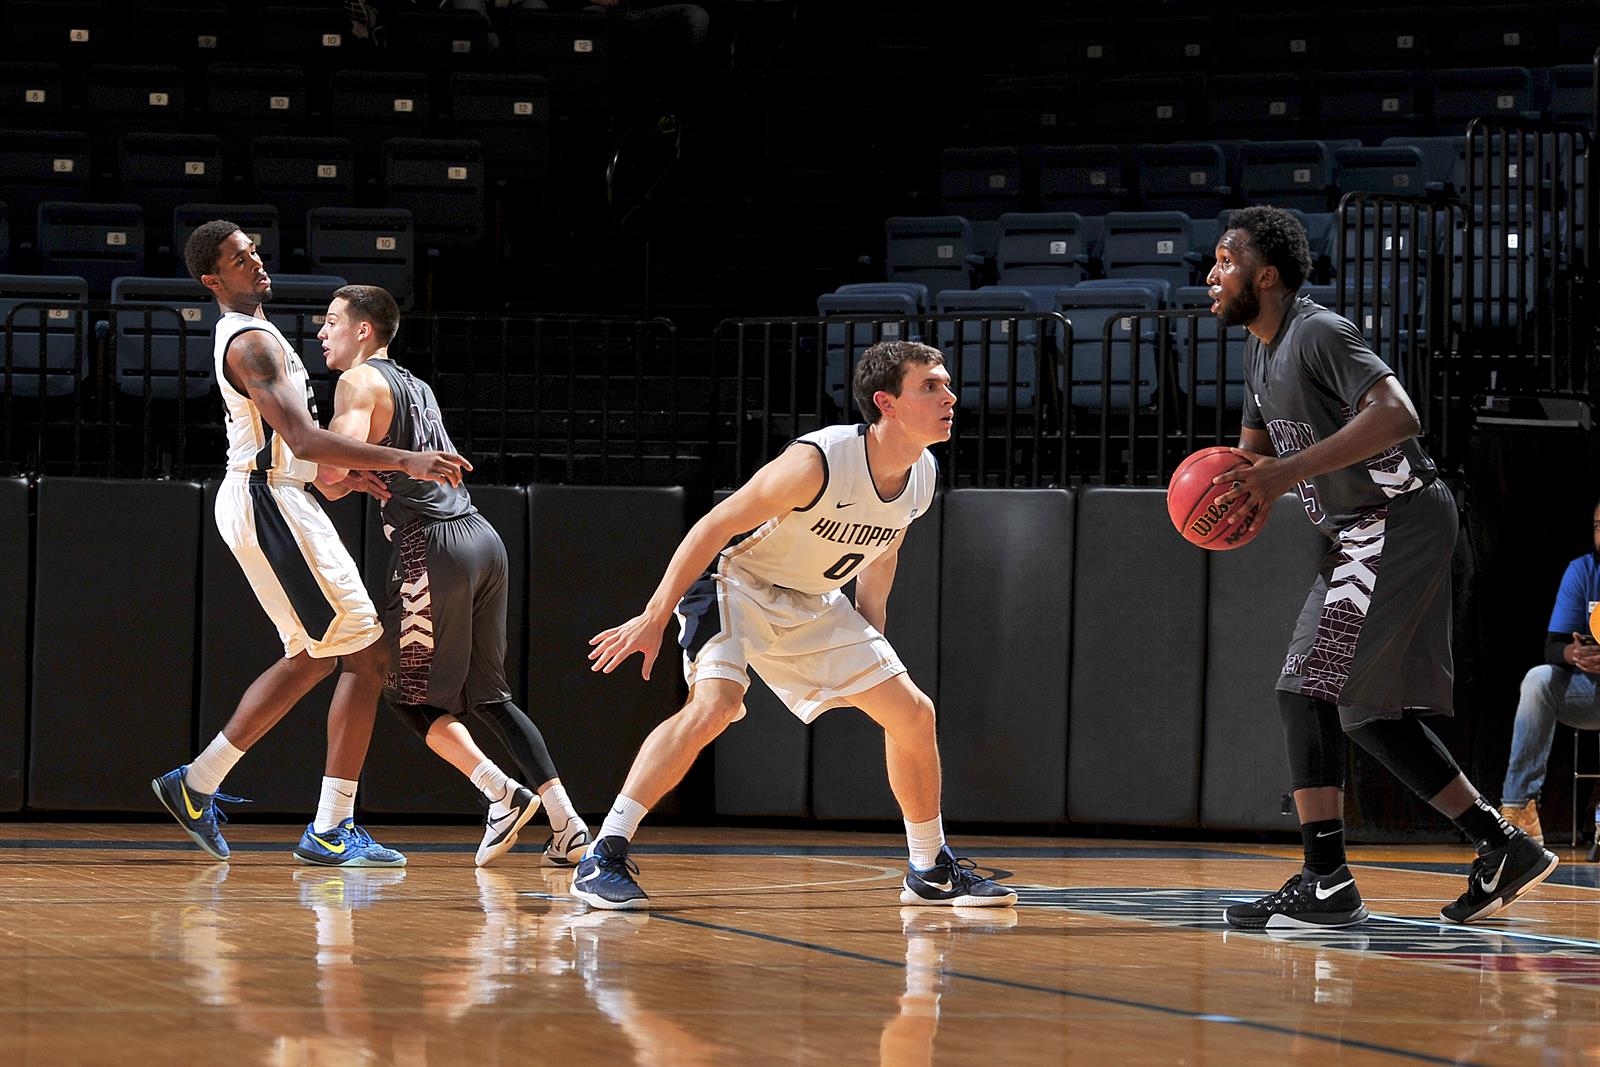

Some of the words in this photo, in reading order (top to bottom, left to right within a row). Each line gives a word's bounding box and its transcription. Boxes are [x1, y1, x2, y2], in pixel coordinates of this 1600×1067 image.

[1189, 481, 1240, 537] Wils
[1297, 480, 1326, 525] 5
[823, 552, 865, 580] 0
